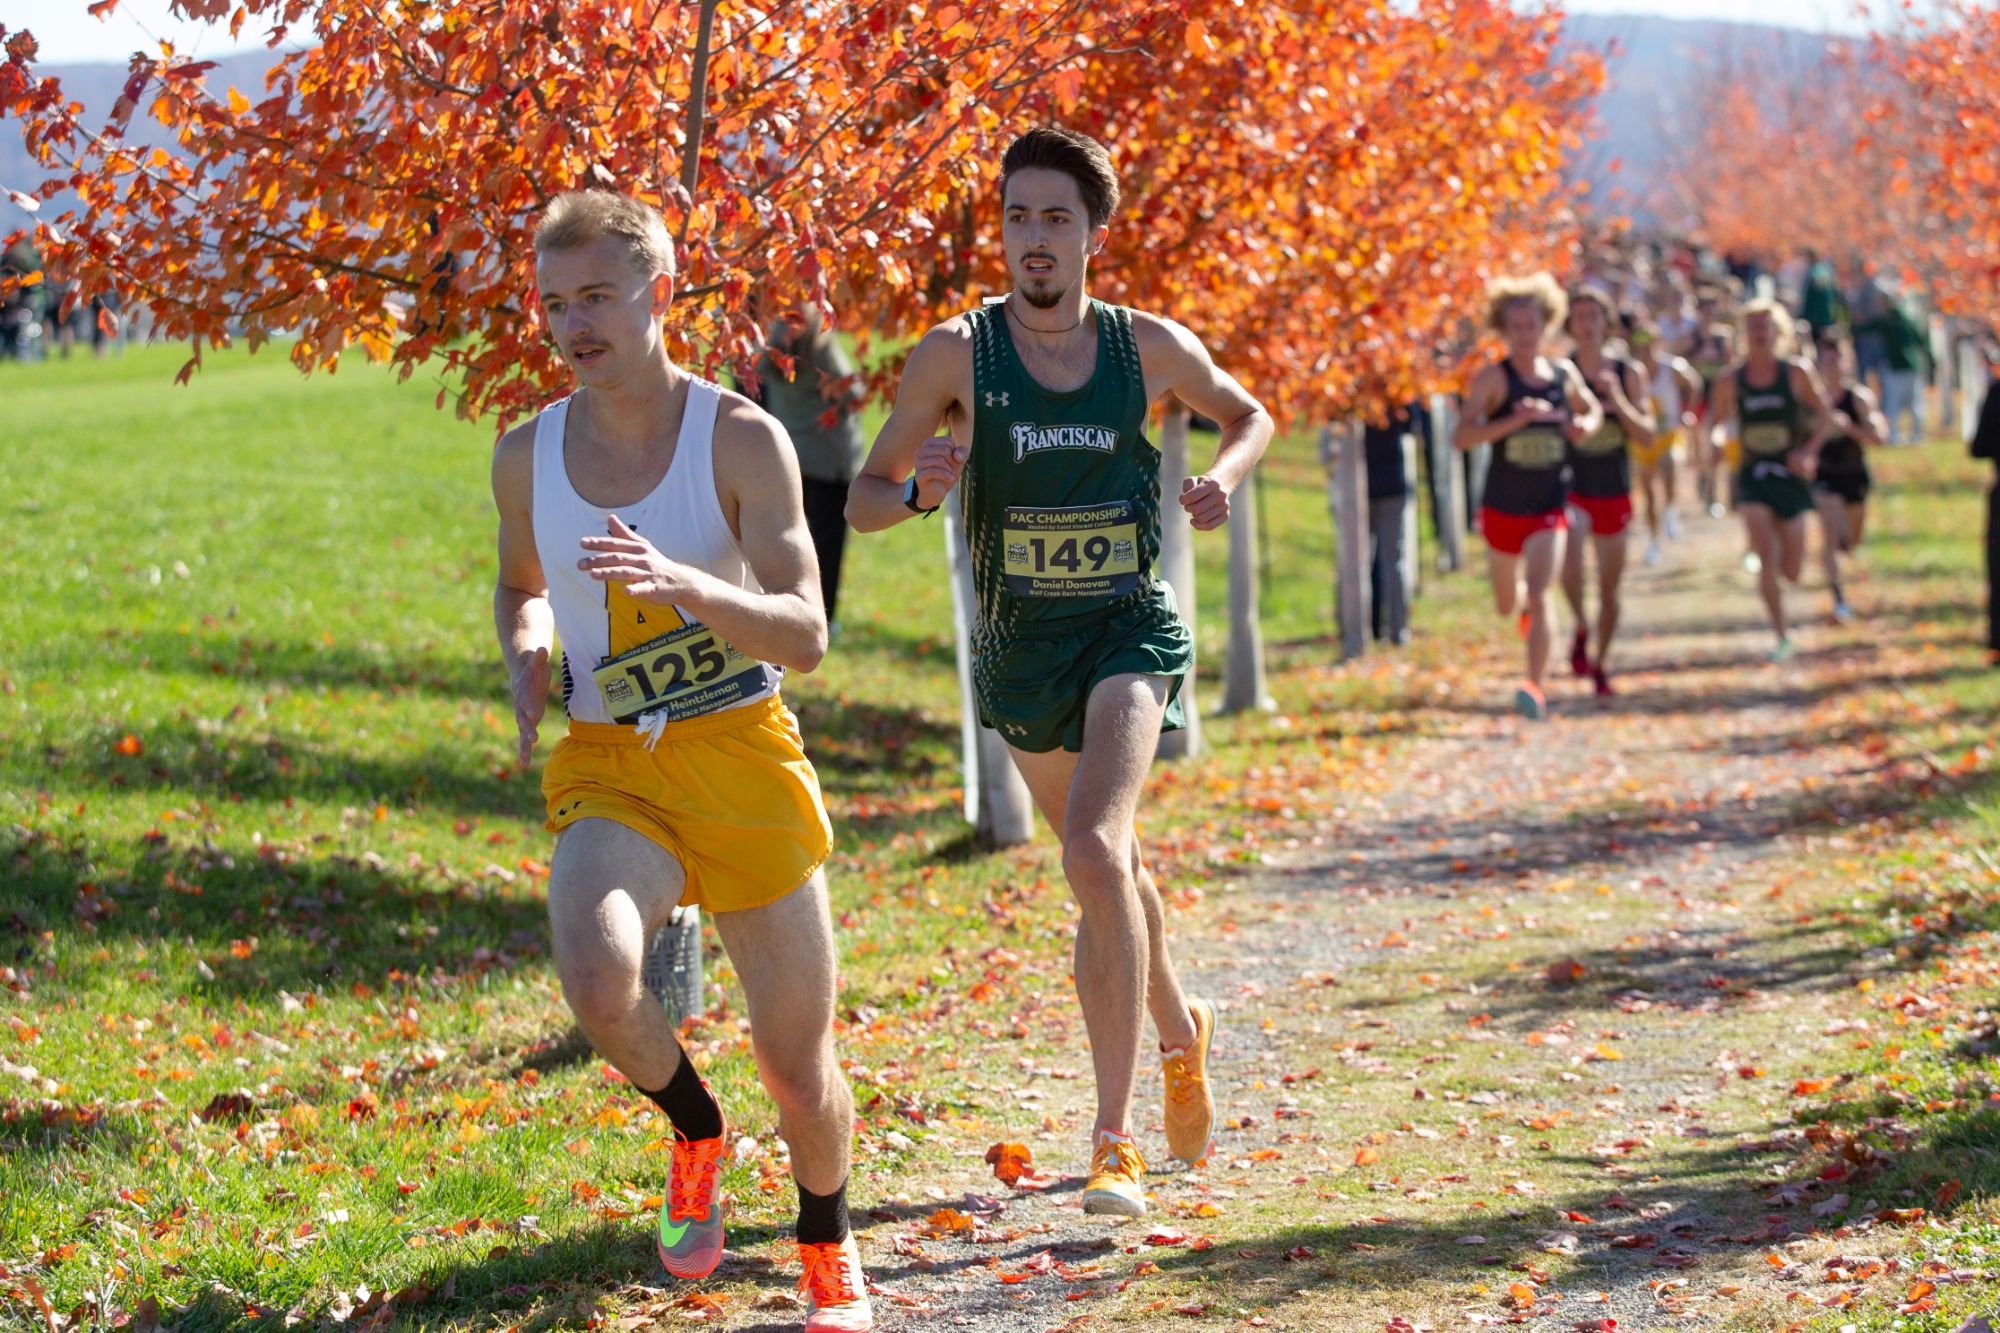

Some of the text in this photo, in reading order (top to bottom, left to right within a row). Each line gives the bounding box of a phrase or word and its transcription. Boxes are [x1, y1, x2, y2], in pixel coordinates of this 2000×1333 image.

[1010, 506, 1128, 524] PAC CHAMPIONSHIPS
[1049, 523, 1056, 531] by
[1072, 522, 1093, 530] Vincent
[1094, 520, 1113, 528] College
[1029, 535, 1111, 573] 149
[1032, 579, 1110, 589] Daniel Donovan
[1077, 588, 1115, 597] Management
[667, 629, 693, 642] Vincent
[625, 636, 726, 702] 125
[669, 681, 740, 711] Heintzleman
[681, 707, 699, 719] Race
[699, 691, 743, 714] Management
